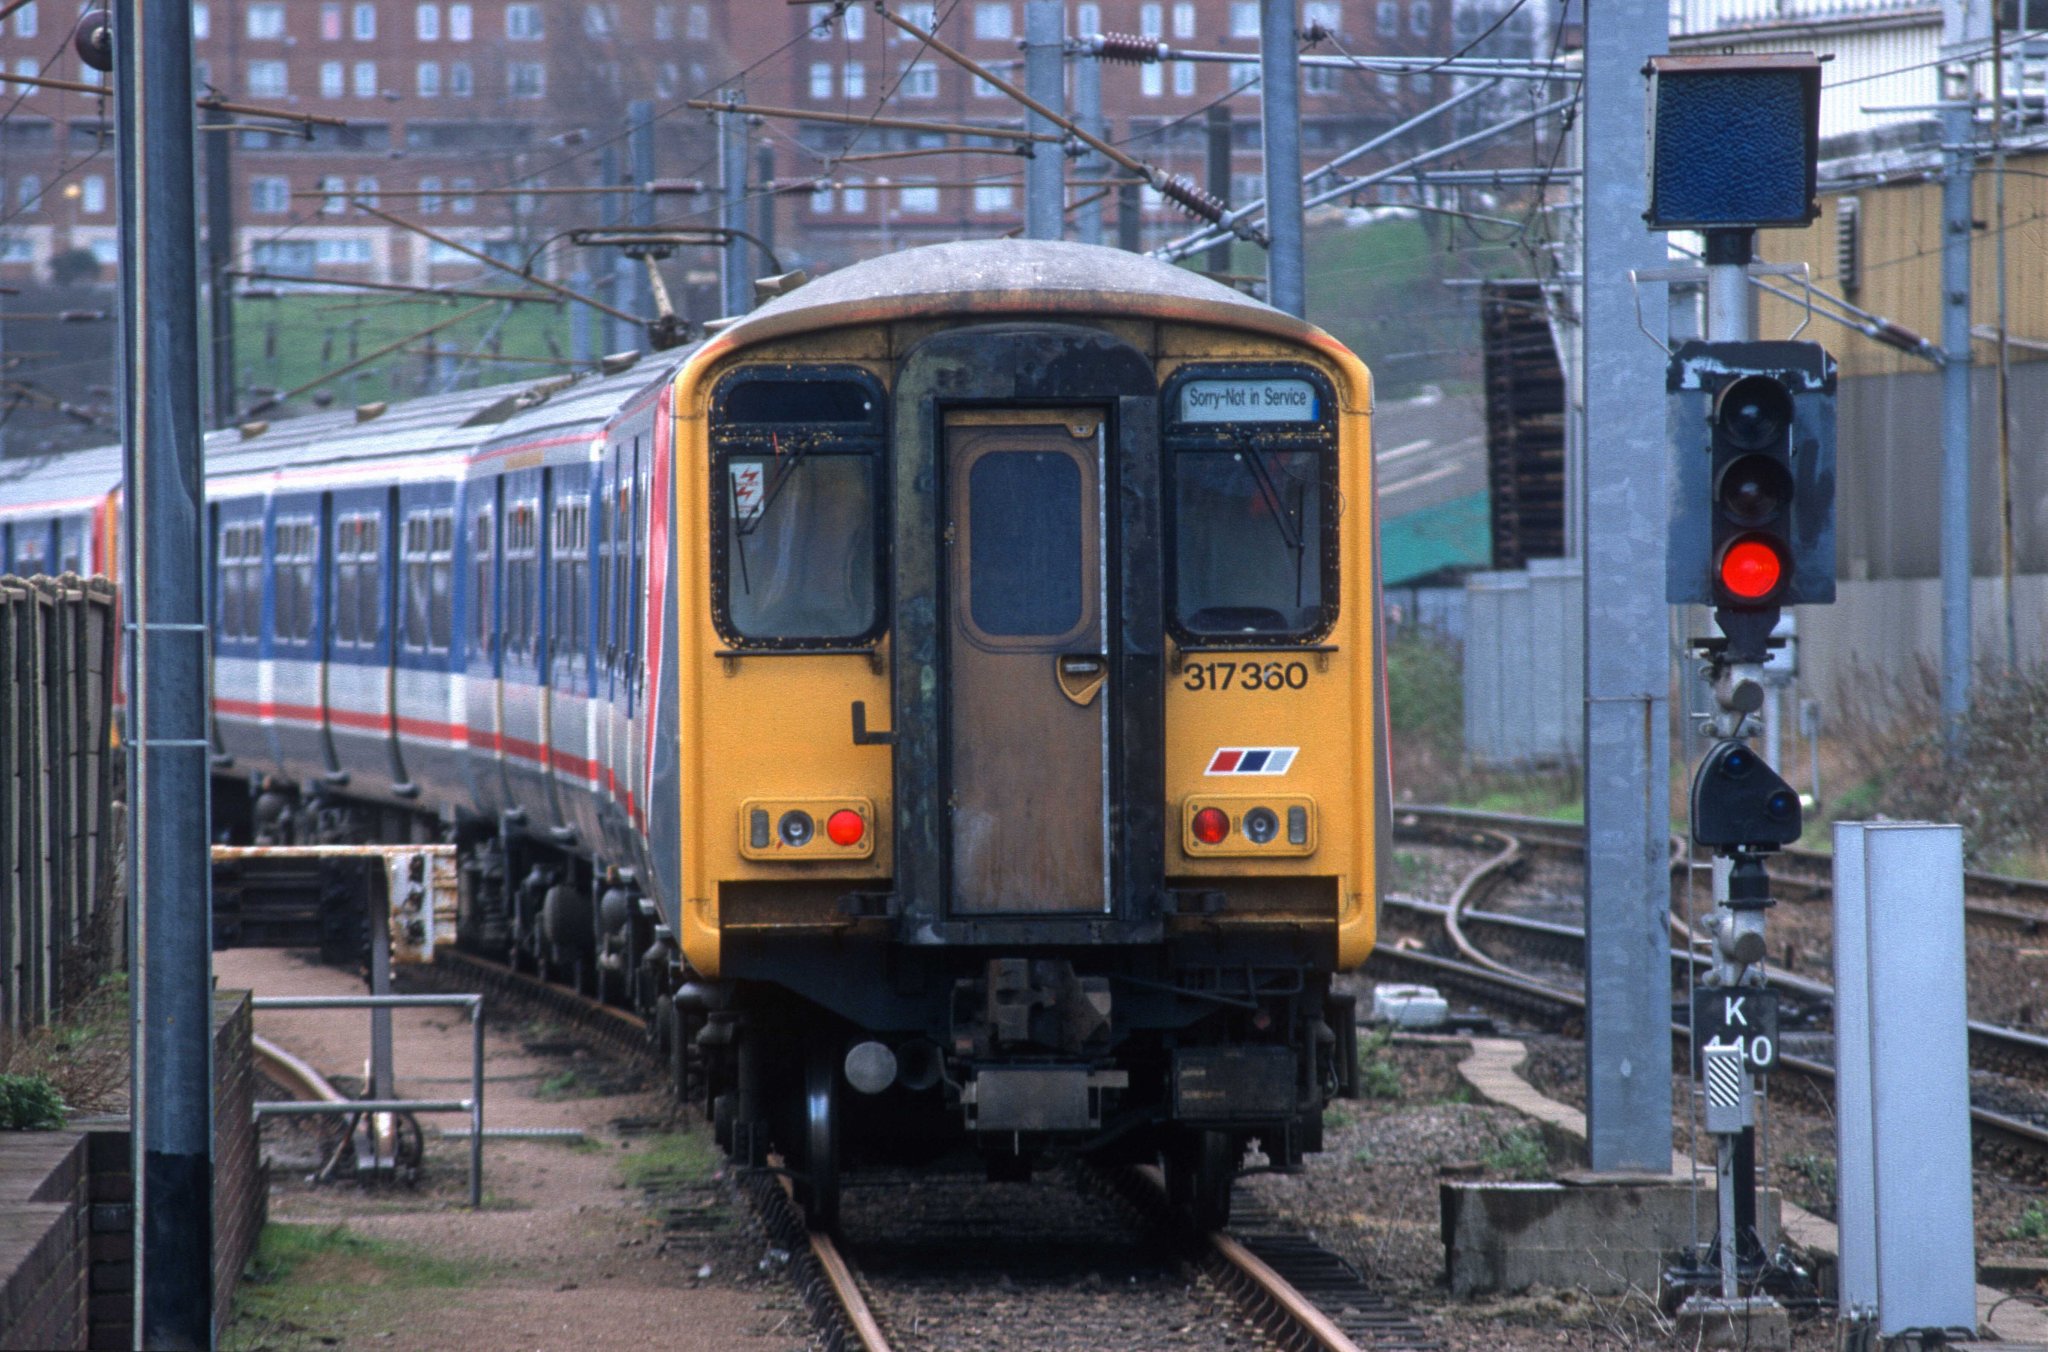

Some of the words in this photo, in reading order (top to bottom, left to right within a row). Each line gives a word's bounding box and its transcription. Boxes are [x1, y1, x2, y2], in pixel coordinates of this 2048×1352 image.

[1250, 387, 1260, 406] in
[1264, 387, 1307, 406] Service
[1725, 996, 1748, 1026] K
[1707, 1035, 1772, 1065] 40
